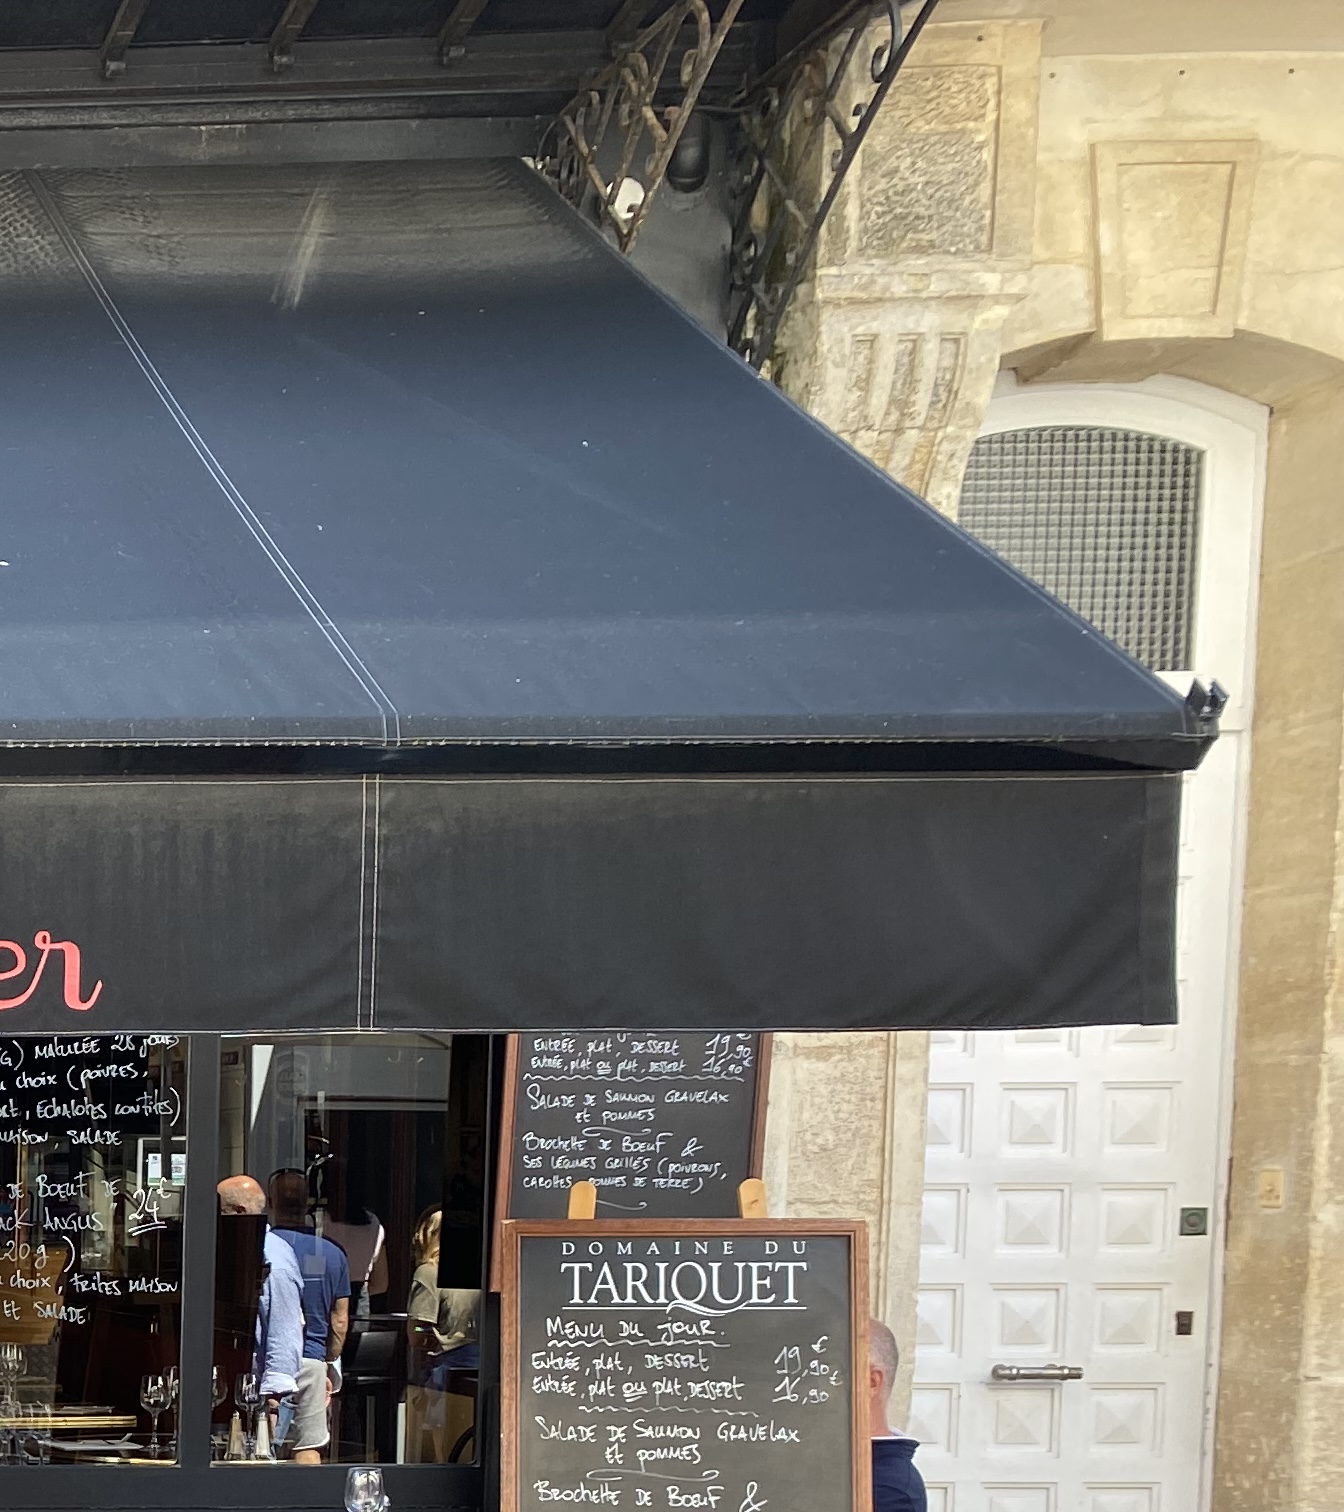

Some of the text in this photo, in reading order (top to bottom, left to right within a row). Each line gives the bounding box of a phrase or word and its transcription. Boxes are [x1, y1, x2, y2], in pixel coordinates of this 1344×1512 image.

[582, 1094, 597, 1107] DE
[598, 1139, 612, 1151] DE
[102, 1178, 121, 1197] DE
[632, 1177, 648, 1188] DE
[562, 1240, 807, 1255] DOMAINE DU
[561, 1261, 808, 1316] TARIQUET
[546, 1316, 604, 1338] MENU
[605, 1425, 627, 1442] DE
[635, 1488, 652, 1507] DE
